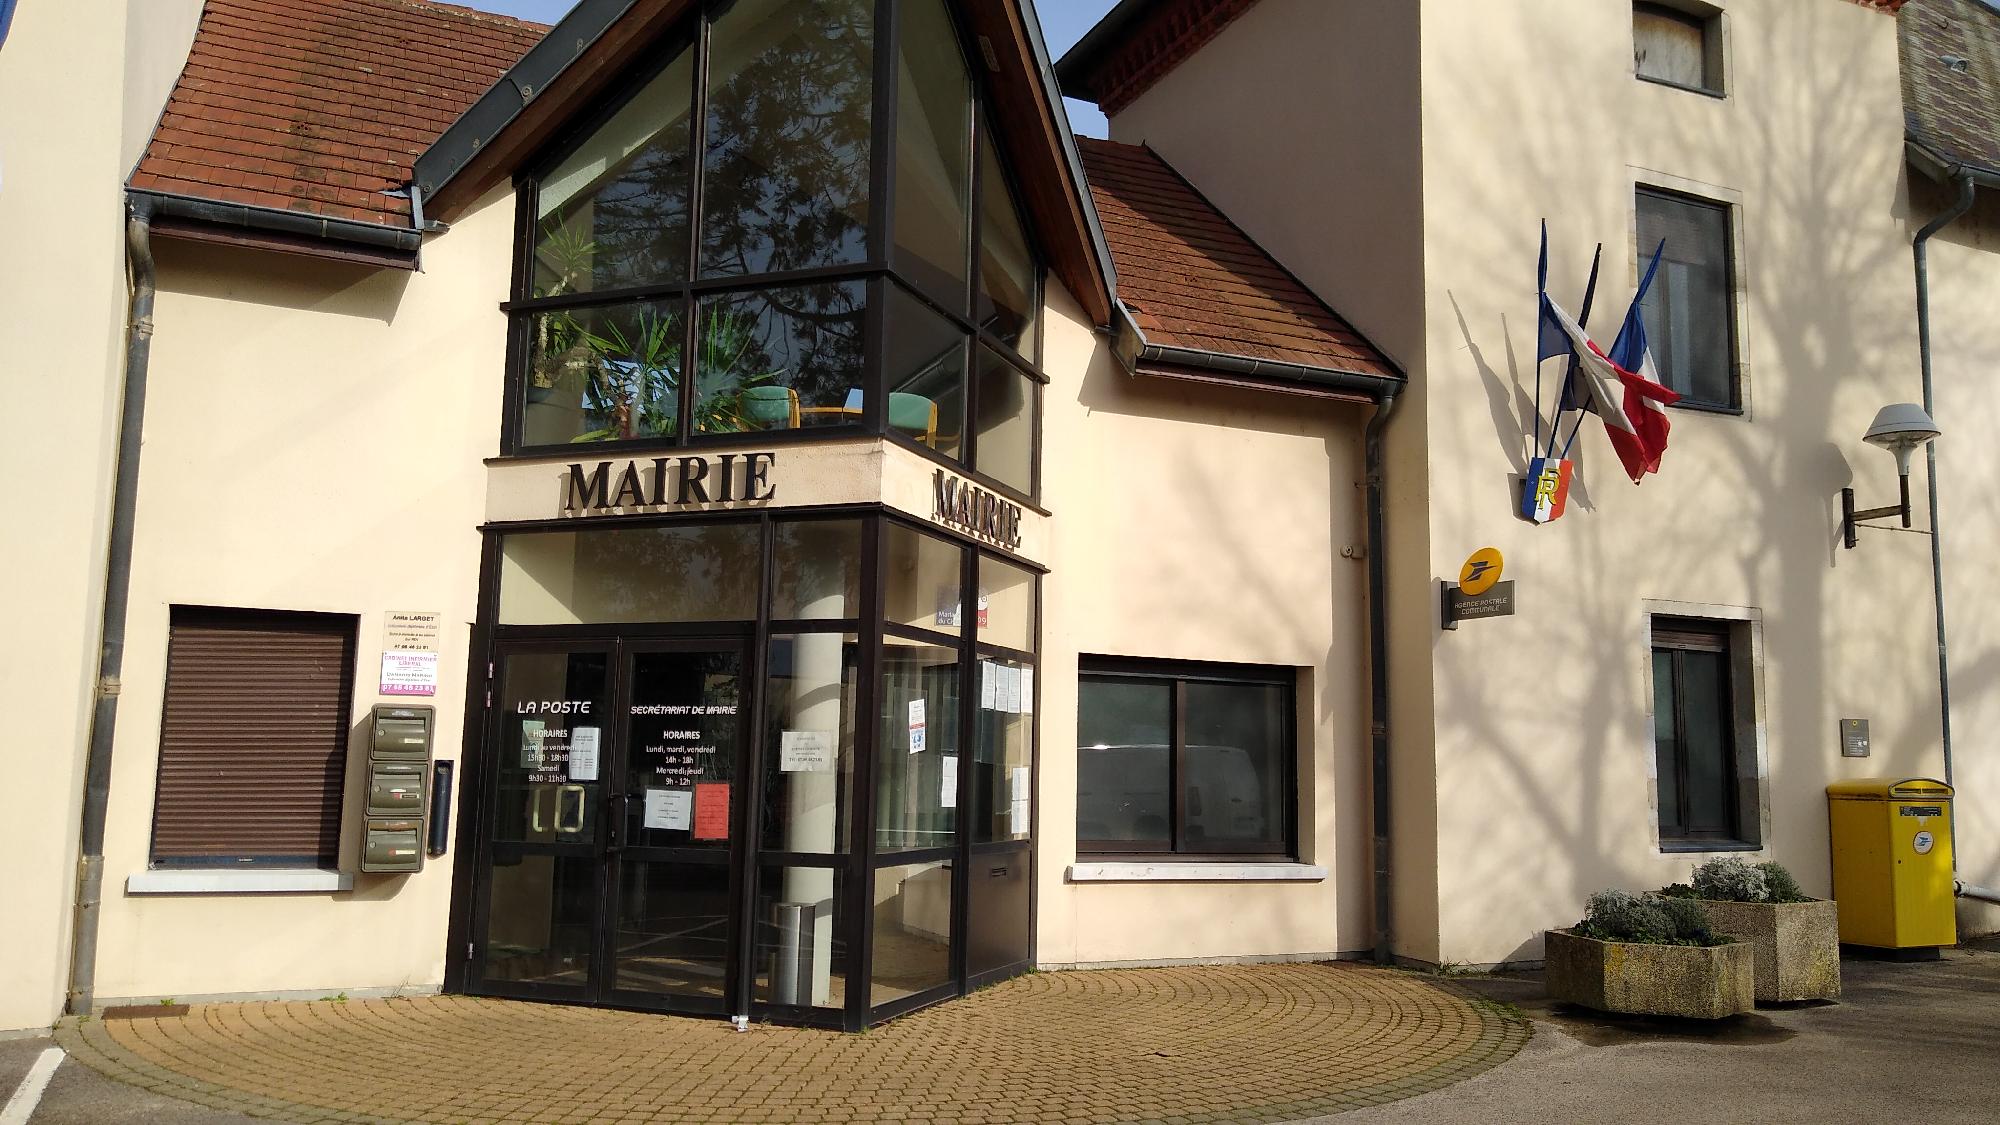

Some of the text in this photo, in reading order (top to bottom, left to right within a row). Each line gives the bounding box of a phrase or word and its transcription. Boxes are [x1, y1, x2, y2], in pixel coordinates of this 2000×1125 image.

[564, 452, 776, 510] MAIRIE
[935, 468, 1022, 549] MAIRIE
[1454, 597, 1508, 609] AGENCE POSTALE
[1461, 604, 1501, 615] COMMUNALE
[517, 701, 592, 714] LA POSTE
[630, 704, 738, 715] SECRÉTARIAT DE MAIRIE
[533, 729, 568, 738] HORAIRES
[663, 730, 701, 740] HORAIRES
[549, 744, 577, 752] vendredi
[687, 746, 716, 754] vendredi
[550, 753, 569, 762] 18h30
[665, 756, 677, 764] 14h
[682, 756, 694, 764] 18h
[537, 764, 560, 772] Samedi
[528, 774, 544, 782] 9h30
[548, 774, 567, 783] 11h30
[665, 777, 674, 785] 9h
[679, 777, 691, 786] 12h
